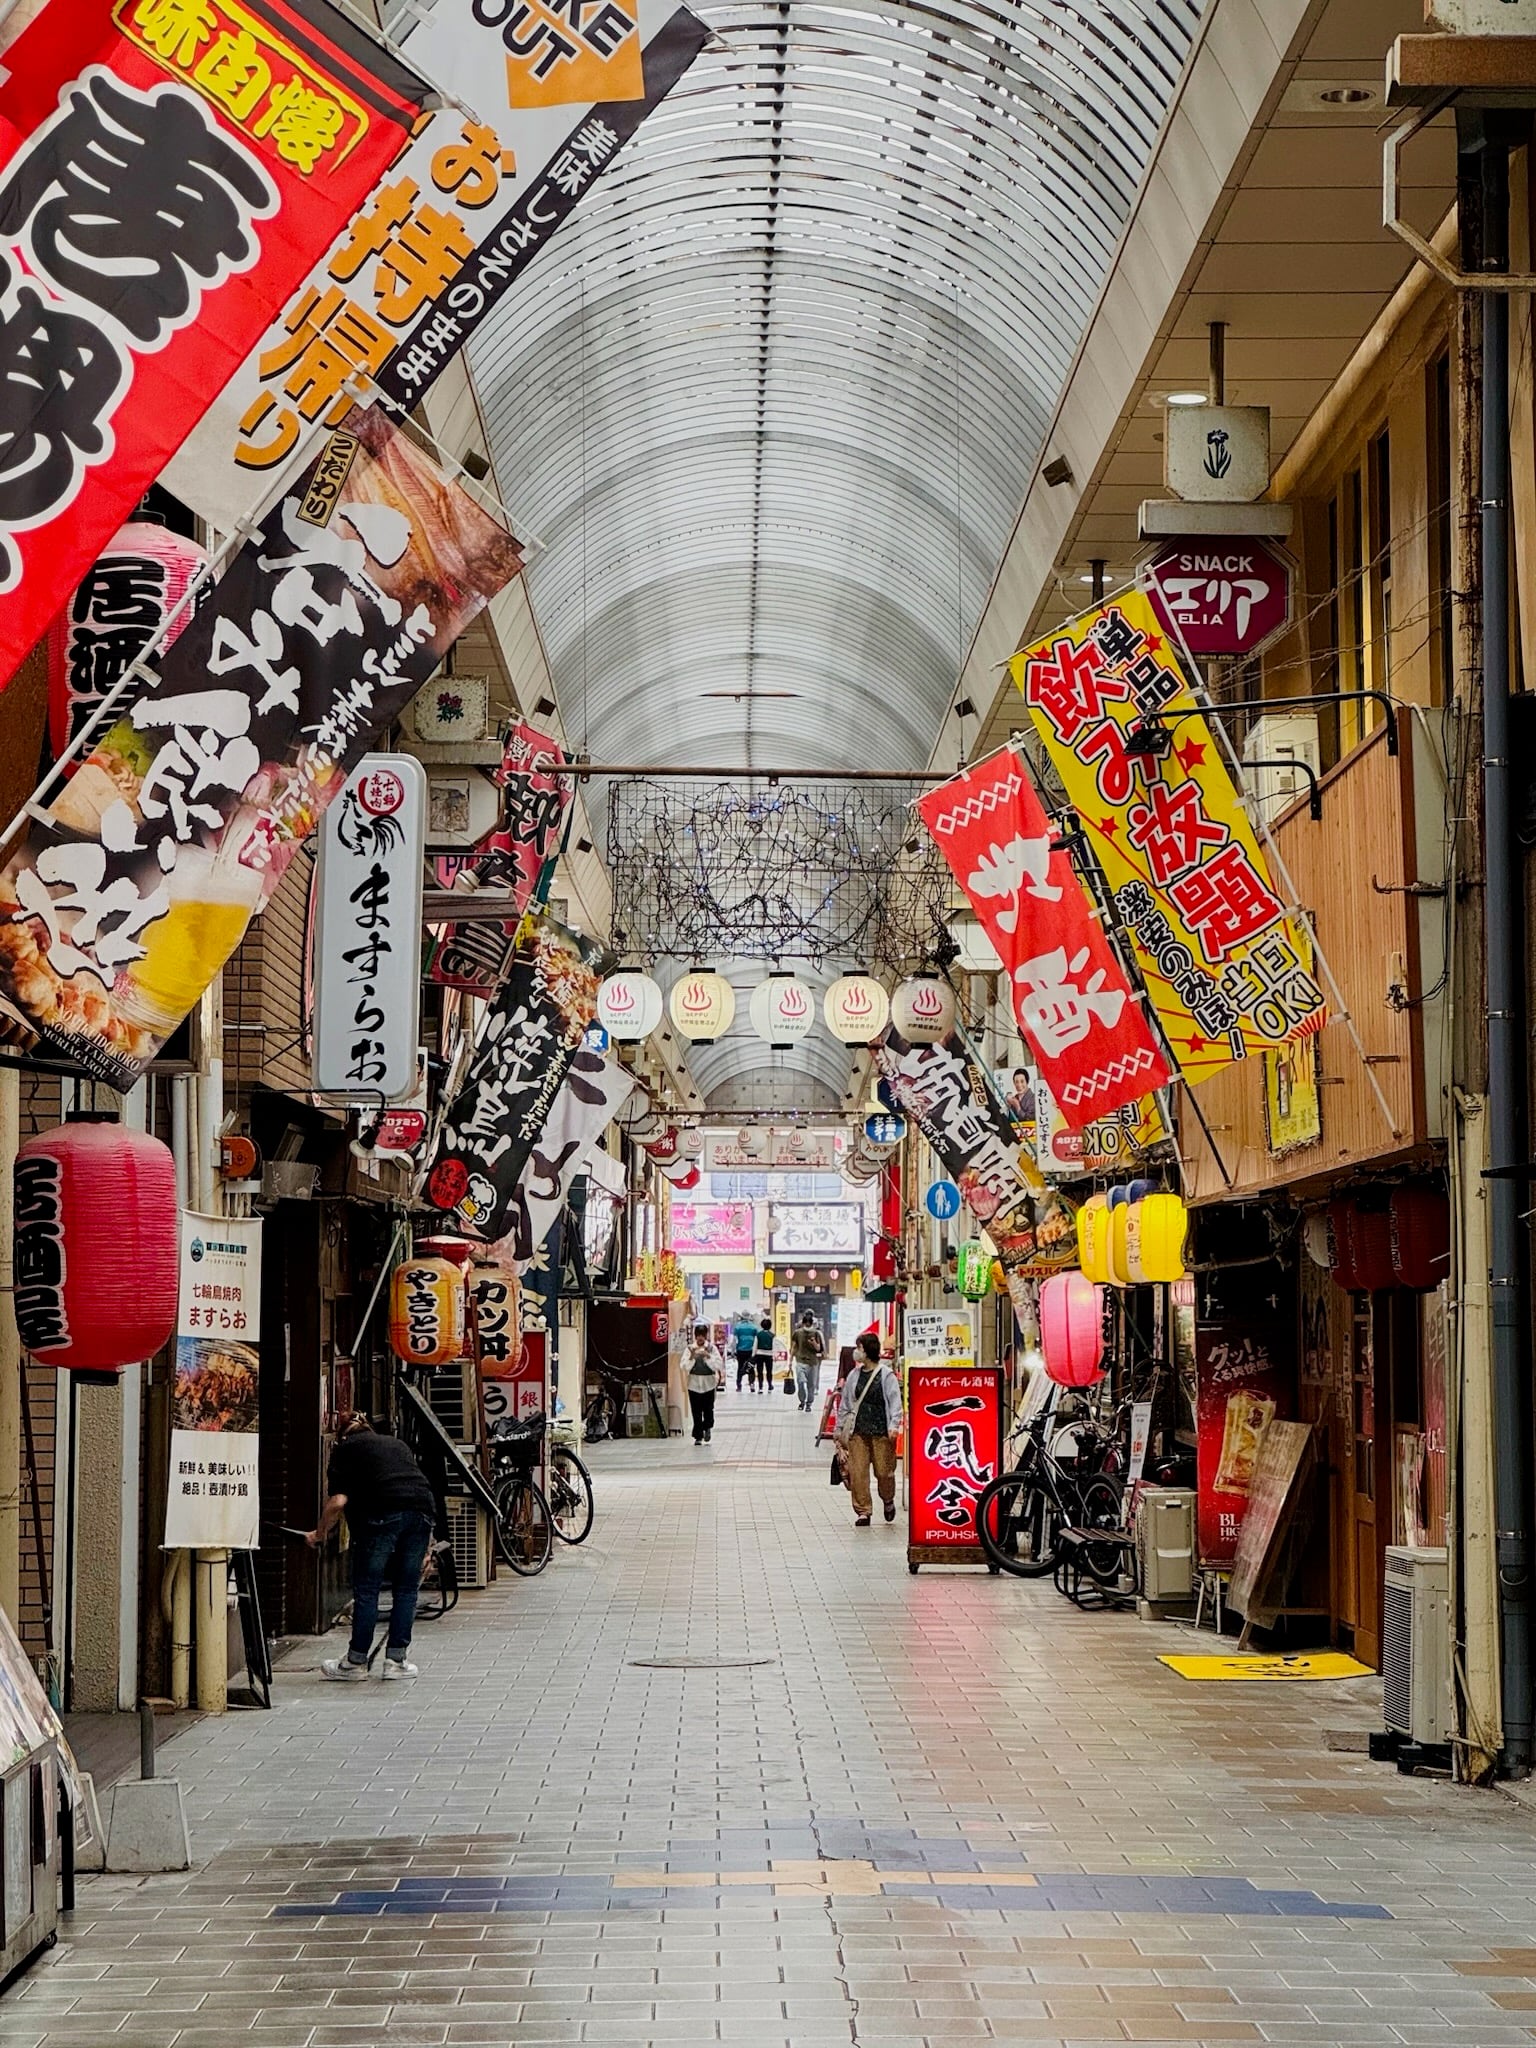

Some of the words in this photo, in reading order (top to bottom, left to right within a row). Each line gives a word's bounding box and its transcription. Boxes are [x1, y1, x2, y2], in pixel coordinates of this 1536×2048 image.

[234, 120, 517, 470] お持帰り
[304, 436, 356, 522] こだわり
[1180, 554, 1254, 573] SNACK
[1162, 578, 1270, 641] エリア
[1178, 613, 1224, 625] ELIA
[1090, 608, 1183, 712] 単品
[1027, 640, 1283, 960] 飲み放題
[341, 864, 395, 1082] ますらお
[1115, 881, 1248, 1059] 激安のみほ!
[1221, 936, 1297, 1007] 当日
[1255, 972, 1323, 1039] OK!
[445, 1004, 552, 1168] 焼鳥
[394, 1126, 404, 1135] C
[189, 1306, 248, 1329] ますらお
[405, 1269, 439, 1354] やきとり
[471, 1280, 511, 1361] カツ丼
[911, 1325, 944, 1336] 生ビール
[919, 1376, 995, 1388] ハイボール酒場
[1219, 1513, 1242, 1527] BL
[1220, 1527, 1241, 1537] HIG
